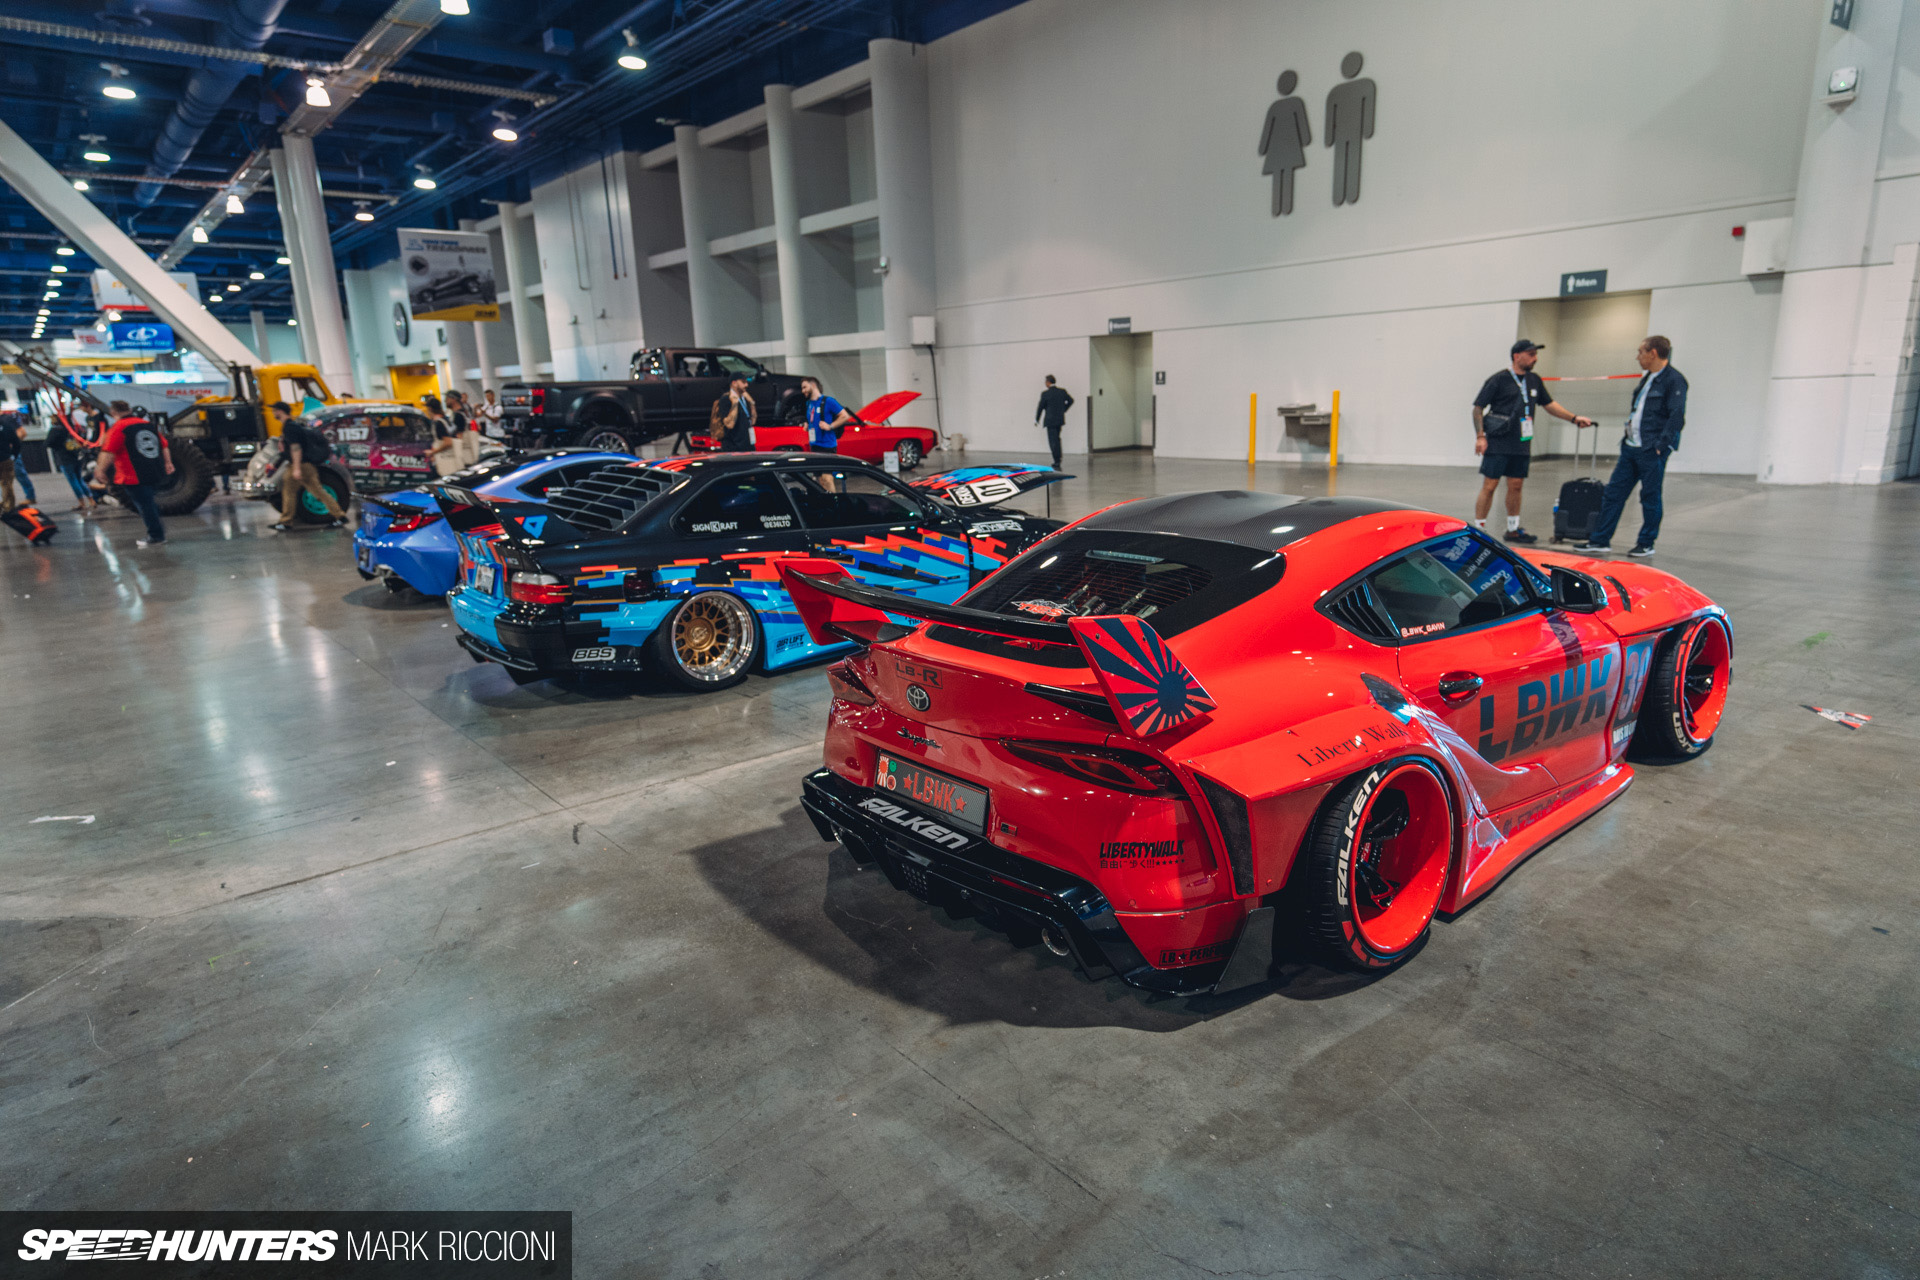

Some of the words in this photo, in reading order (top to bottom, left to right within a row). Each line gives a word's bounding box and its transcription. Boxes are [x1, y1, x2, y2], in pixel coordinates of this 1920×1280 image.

[574, 647, 613, 660] BBS
[896, 662, 940, 687] LB-R
[1478, 653, 1613, 765] LBWK
[896, 726, 942, 749] Supra
[1297, 737, 1370, 767] Liberty
[1362, 722, 1409, 743] Walk
[912, 771, 956, 813] LBWK
[857, 797, 969, 850] FALKEN
[1337, 770, 1380, 906] FALKEN
[1099, 839, 1185, 859] LIBERTYWALK
[1161, 952, 1176, 963] LB
